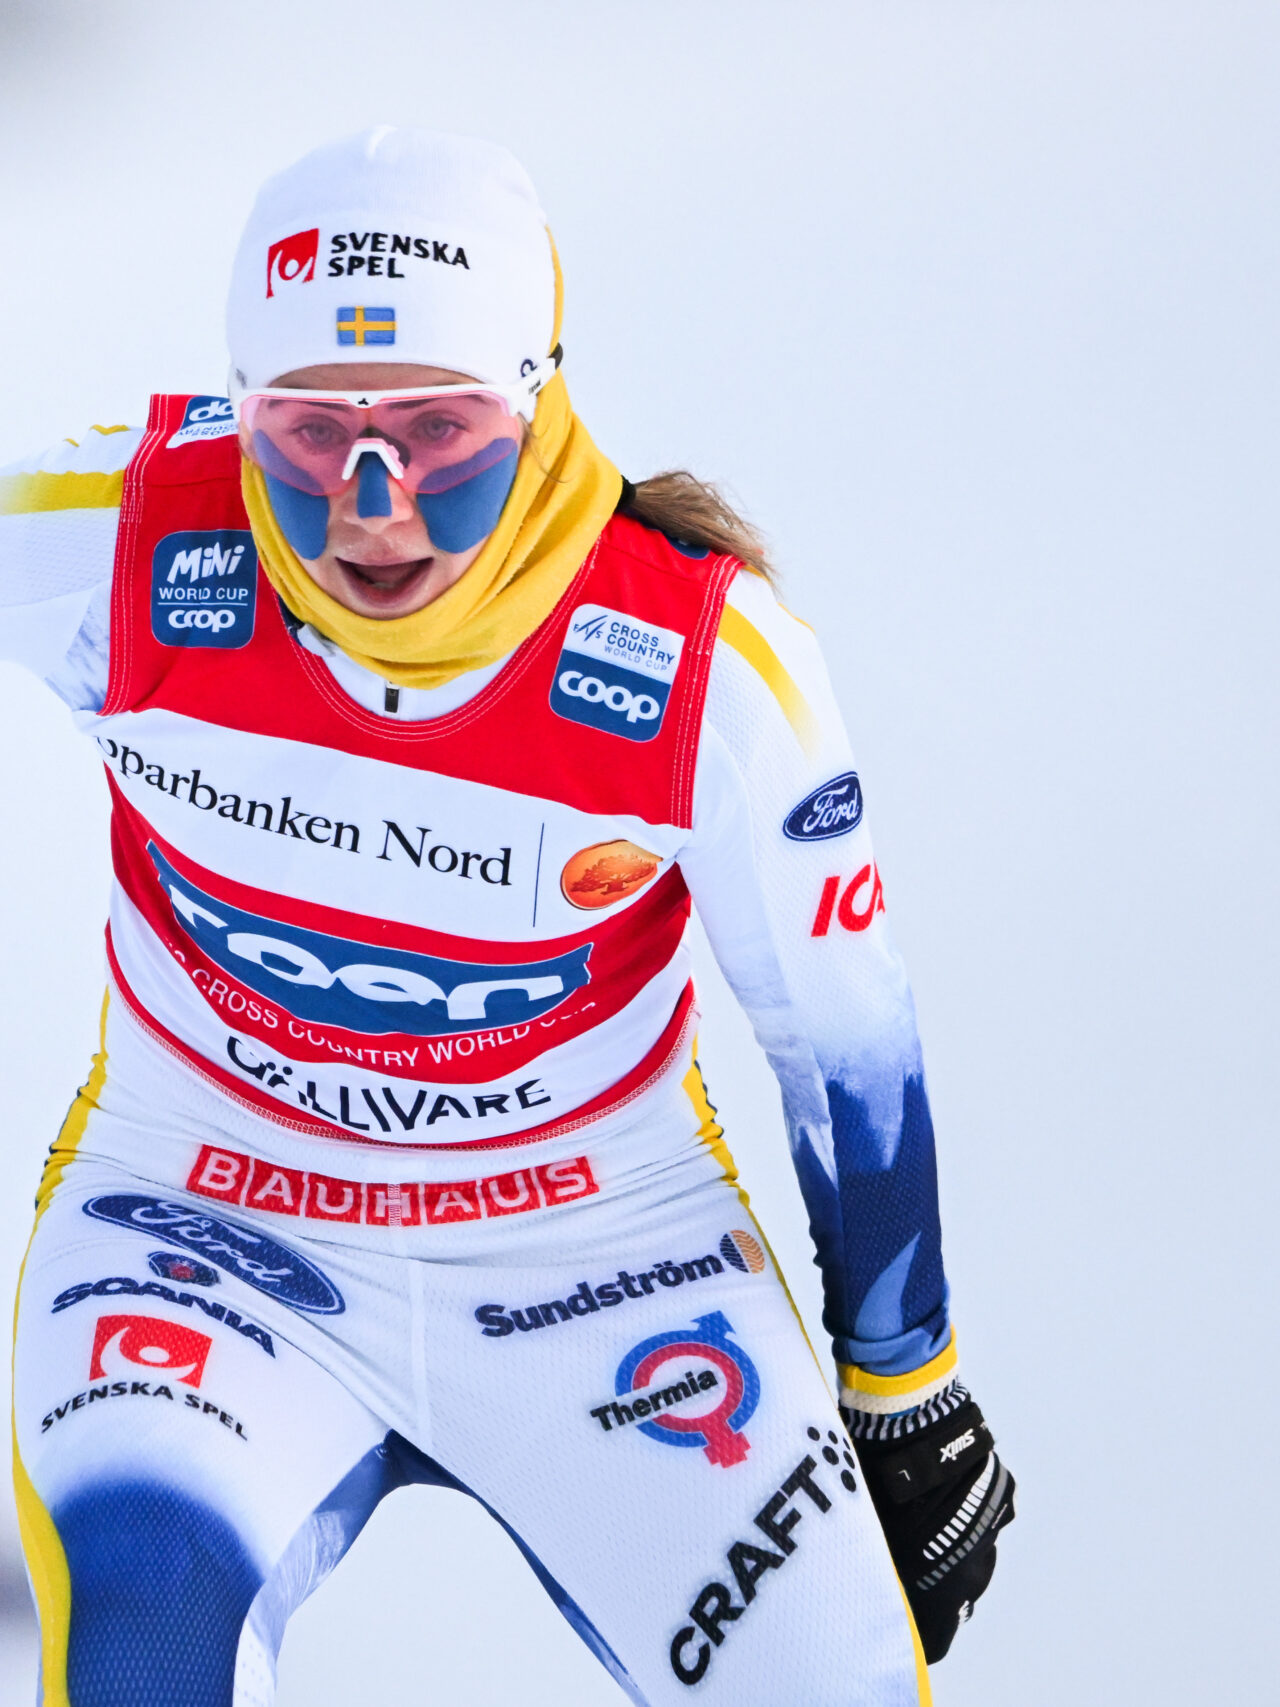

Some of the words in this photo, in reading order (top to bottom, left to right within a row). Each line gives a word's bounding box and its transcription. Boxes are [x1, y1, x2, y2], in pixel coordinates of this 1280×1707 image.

[327, 255, 405, 278] SPEL
[331, 232, 470, 270] SVENSKA
[158, 587, 211, 601] WORLD
[216, 587, 249, 601] CUP
[168, 609, 236, 633] coop
[610, 621, 659, 648] CROSS
[604, 645, 641, 663] WORLD
[645, 659, 668, 673] CUP
[606, 634, 676, 665] COUNTRY
[558, 670, 660, 723] coop
[97, 736, 361, 853] parbanken
[376, 820, 513, 887] Nord
[803, 784, 859, 833] Ford
[811, 857, 886, 937] IC
[428, 1025, 530, 1064] WORLD
[198, 1156, 587, 1219] BAUHAUS
[131, 1201, 294, 1285] Ford
[50, 1276, 276, 1359] SCANIA
[474, 1253, 725, 1338] Sundström
[41, 1381, 174, 1435] SVENSKA
[185, 1394, 249, 1442] SPEL
[590, 1366, 718, 1432] Thermia
[670, 1454, 832, 1686] CRAFT
